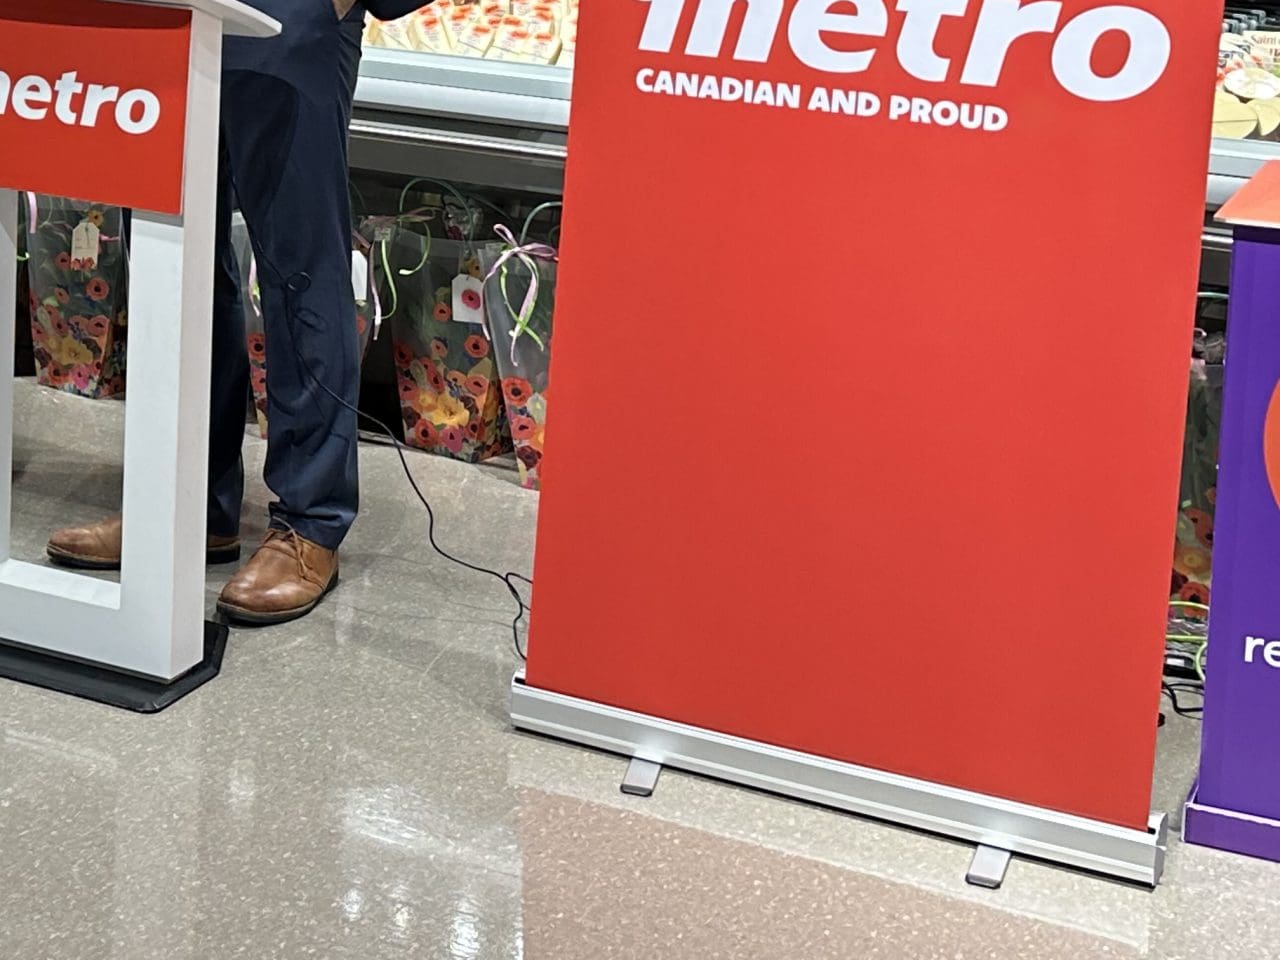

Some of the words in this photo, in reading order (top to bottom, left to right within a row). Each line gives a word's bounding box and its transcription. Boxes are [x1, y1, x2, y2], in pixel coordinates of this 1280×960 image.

[635, 68, 801, 109] CANADIAN
[807, 86, 881, 116] AND
[888, 96, 1008, 132] PROUD
